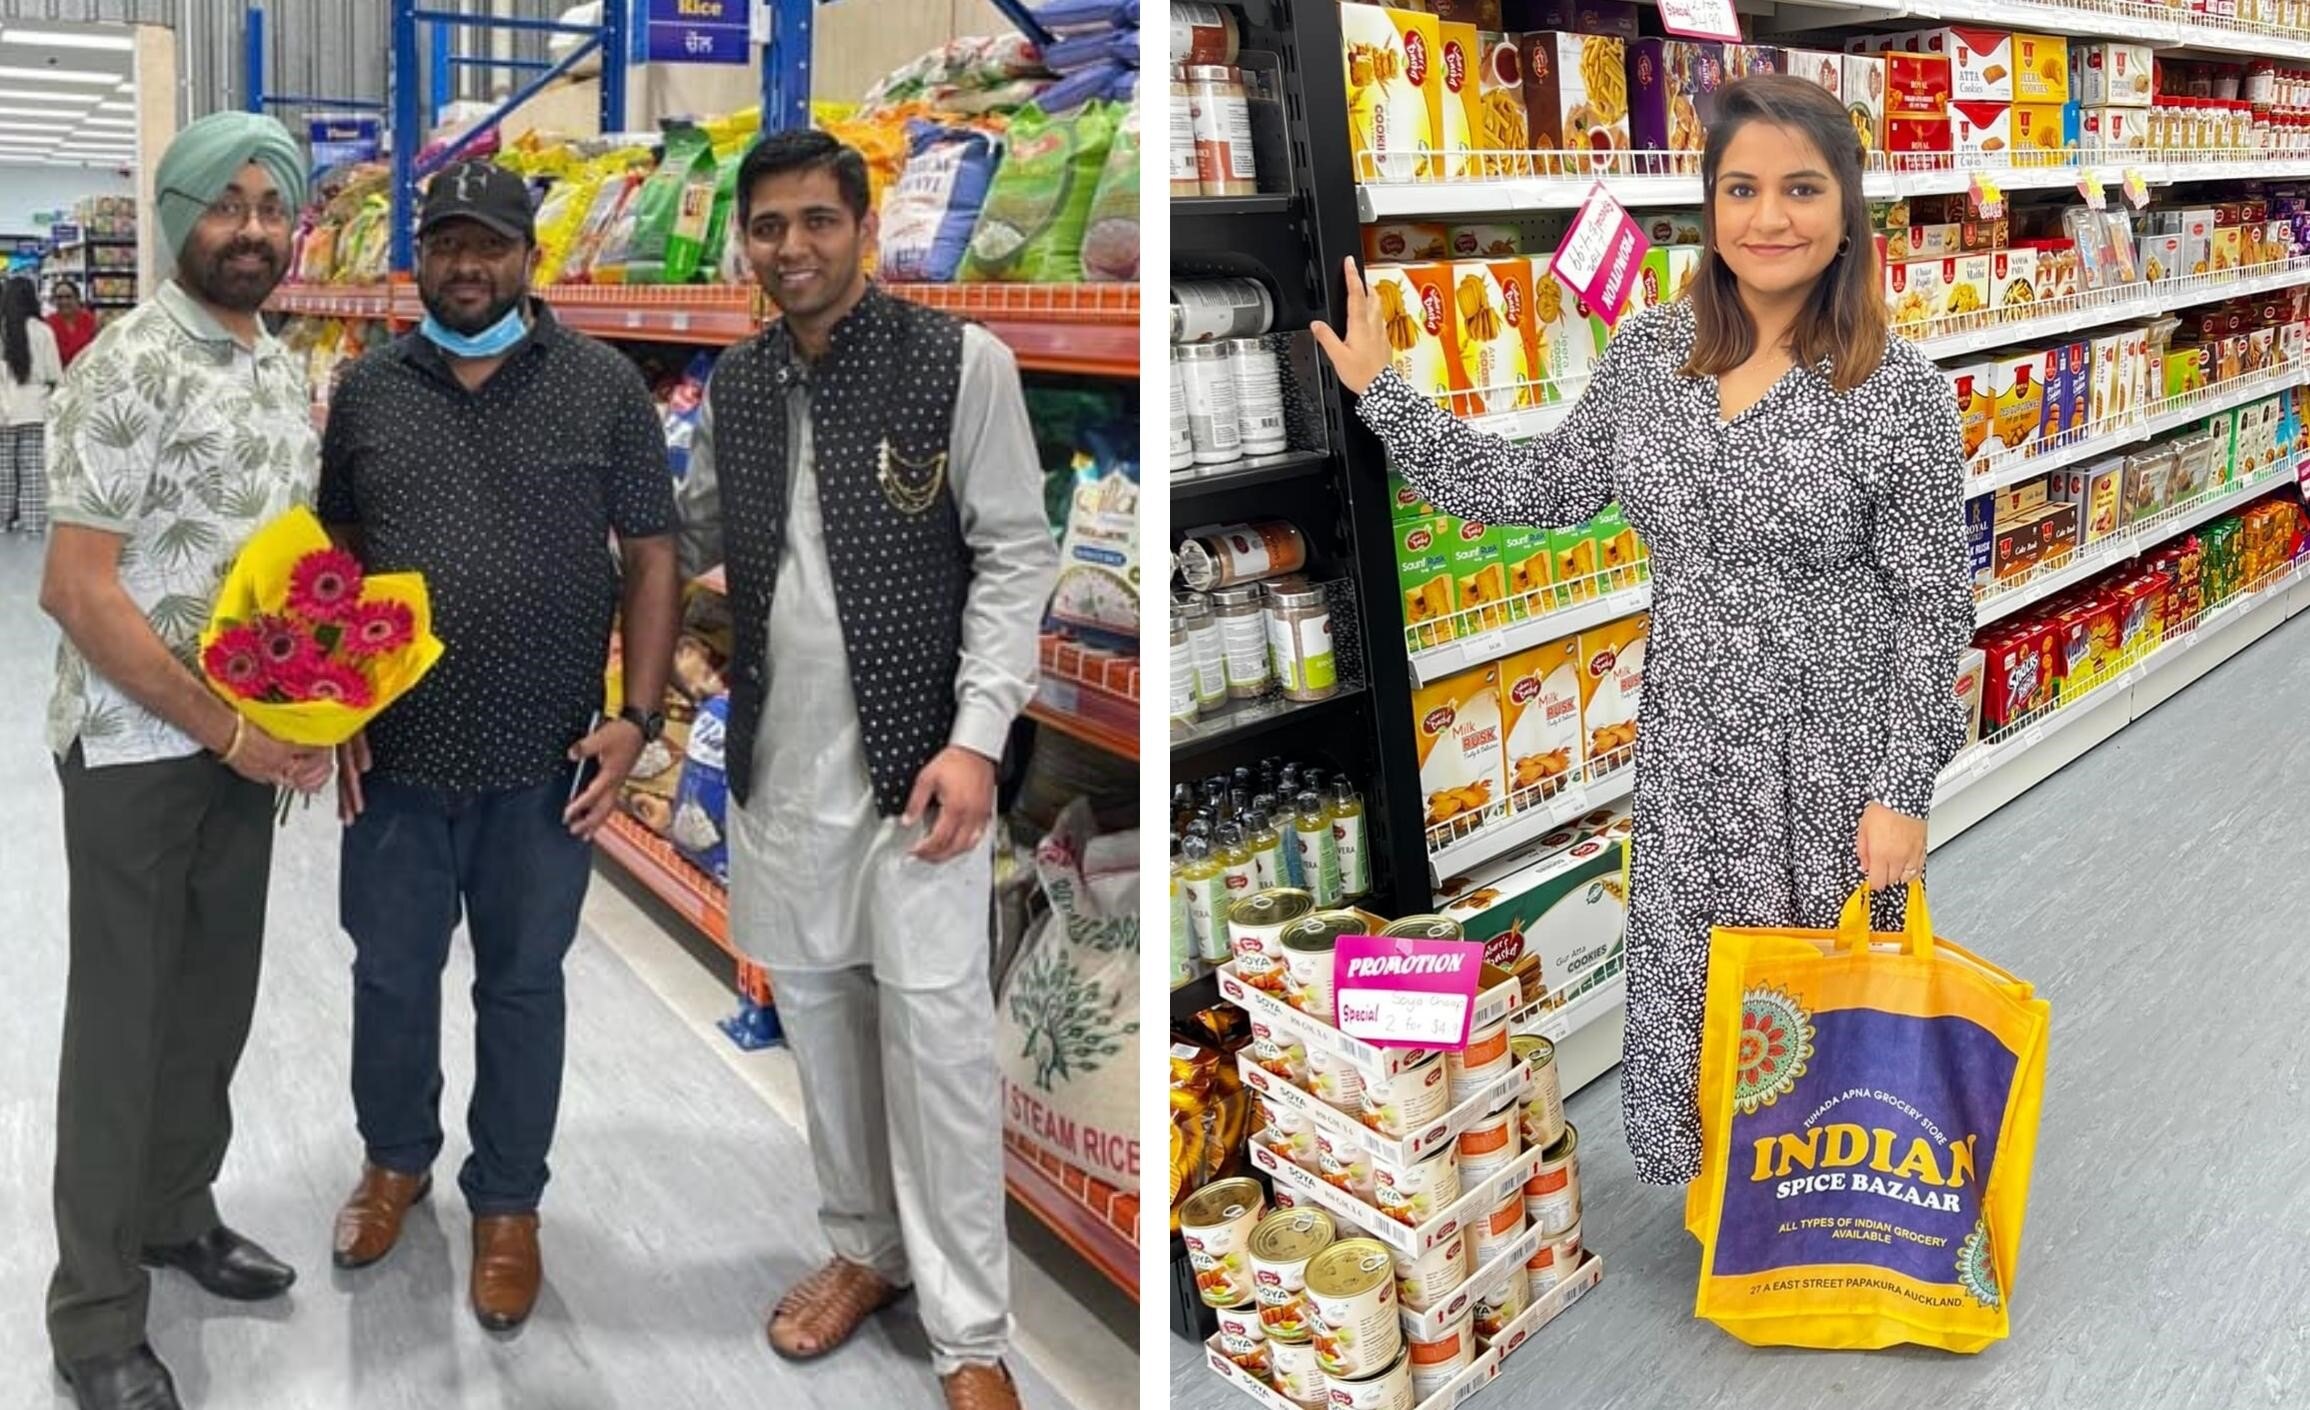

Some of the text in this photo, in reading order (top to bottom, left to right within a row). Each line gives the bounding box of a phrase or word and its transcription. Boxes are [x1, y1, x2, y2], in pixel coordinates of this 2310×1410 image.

[1375, 104, 1387, 163] COOKIS
[1601, 227, 1636, 311] PROMOTION
[1538, 692, 1558, 708] Milk
[1547, 700, 1576, 718] RUSK
[1452, 720, 1476, 739] Milk
[1463, 728, 1497, 750] RUSK
[1347, 953, 1466, 978] PROMOTION
[1567, 944, 1608, 973] COOKIES
[1343, 1003, 1380, 1024] Special
[1384, 1014, 1396, 1032] 2
[1405, 1016, 1422, 1031] for
[1803, 1088, 1947, 1146] TUHADA APNA GROCERY STORE
[1011, 1084, 1140, 1176] STEAM RICE
[1750, 1123, 1977, 1188] INDIAN
[1776, 1173, 1961, 1212] SPICE BAZAAR
[1778, 1217, 1948, 1248] ALL TYPES OF INDIAN GROCERY
[1832, 1229, 1892, 1244] AVAILABLE
[1750, 1285, 1761, 1295] 27
[1763, 1282, 1771, 1292] A
[1772, 1280, 1800, 1291] EAST
[1801, 1278, 1845, 1288] STREET
[1846, 1278, 1902, 1294] PAPAKURA
